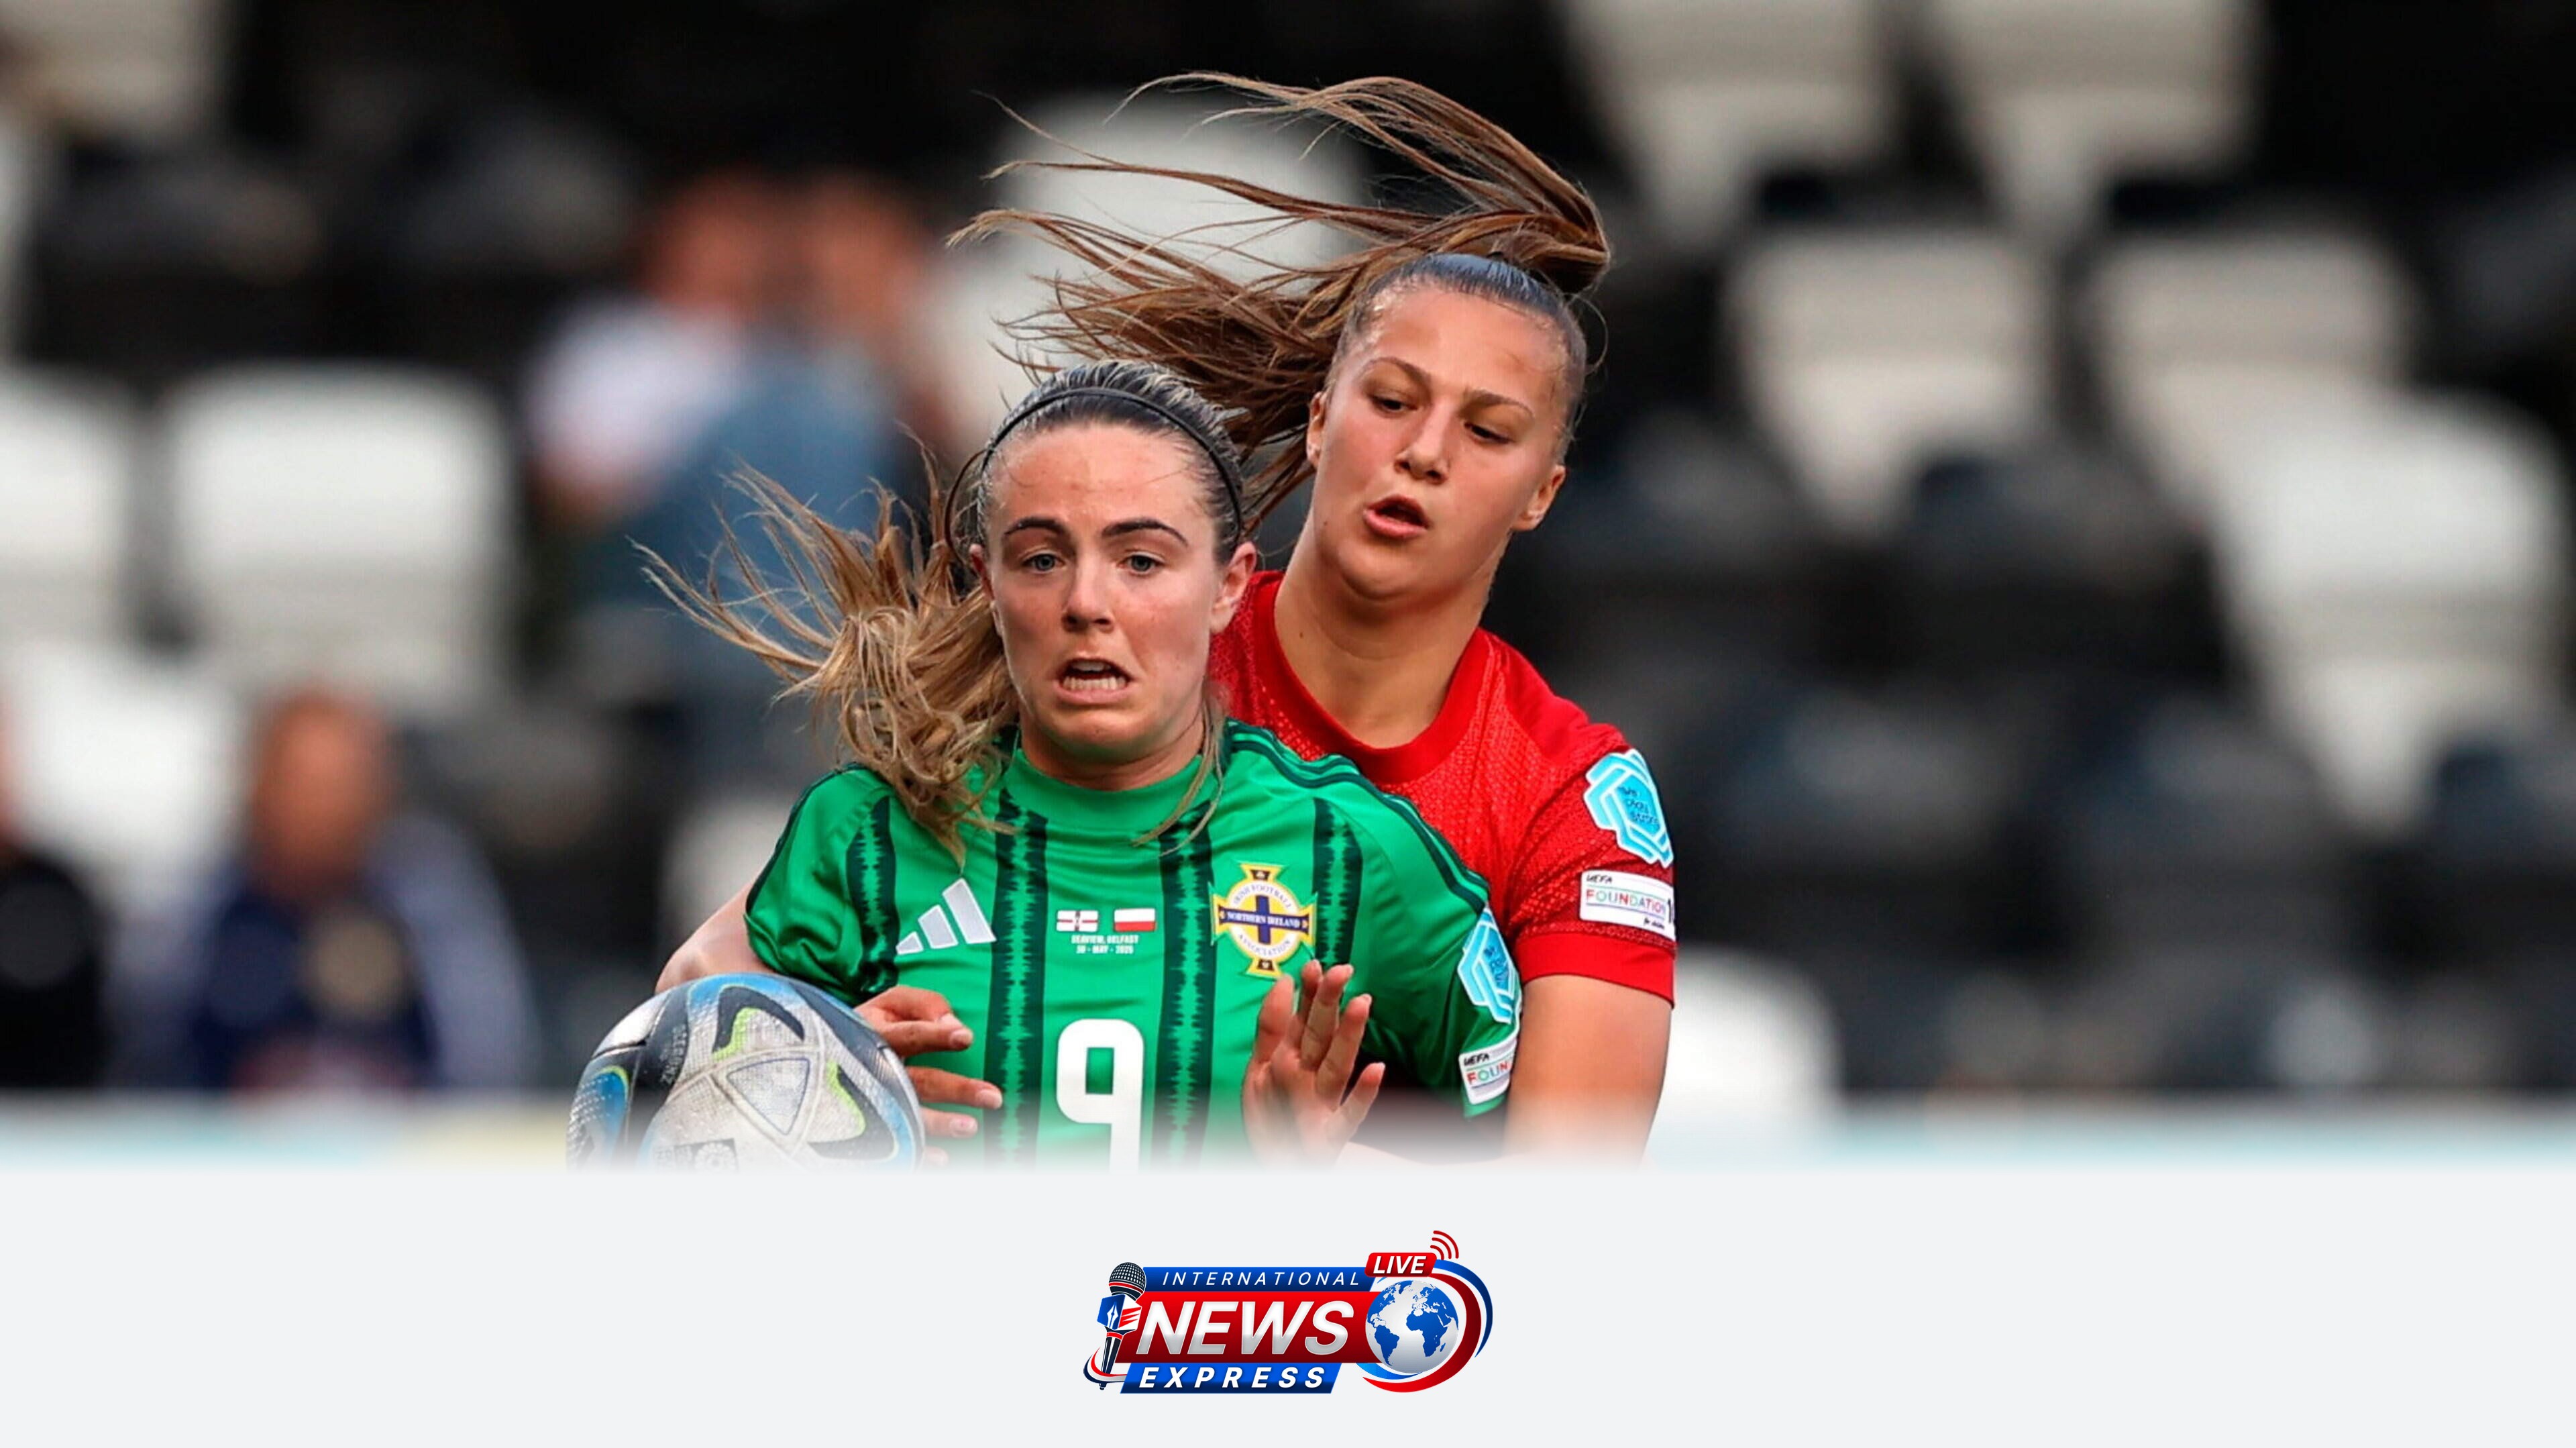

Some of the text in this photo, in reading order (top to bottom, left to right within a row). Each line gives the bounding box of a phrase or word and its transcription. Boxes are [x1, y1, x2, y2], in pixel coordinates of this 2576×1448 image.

[1586, 874, 1613, 884] UEFA
[1227, 911, 1301, 929] NORTHERN IRELAND
[1463, 1053, 1490, 1067] UEFA
[1056, 1018, 1144, 1169] 9
